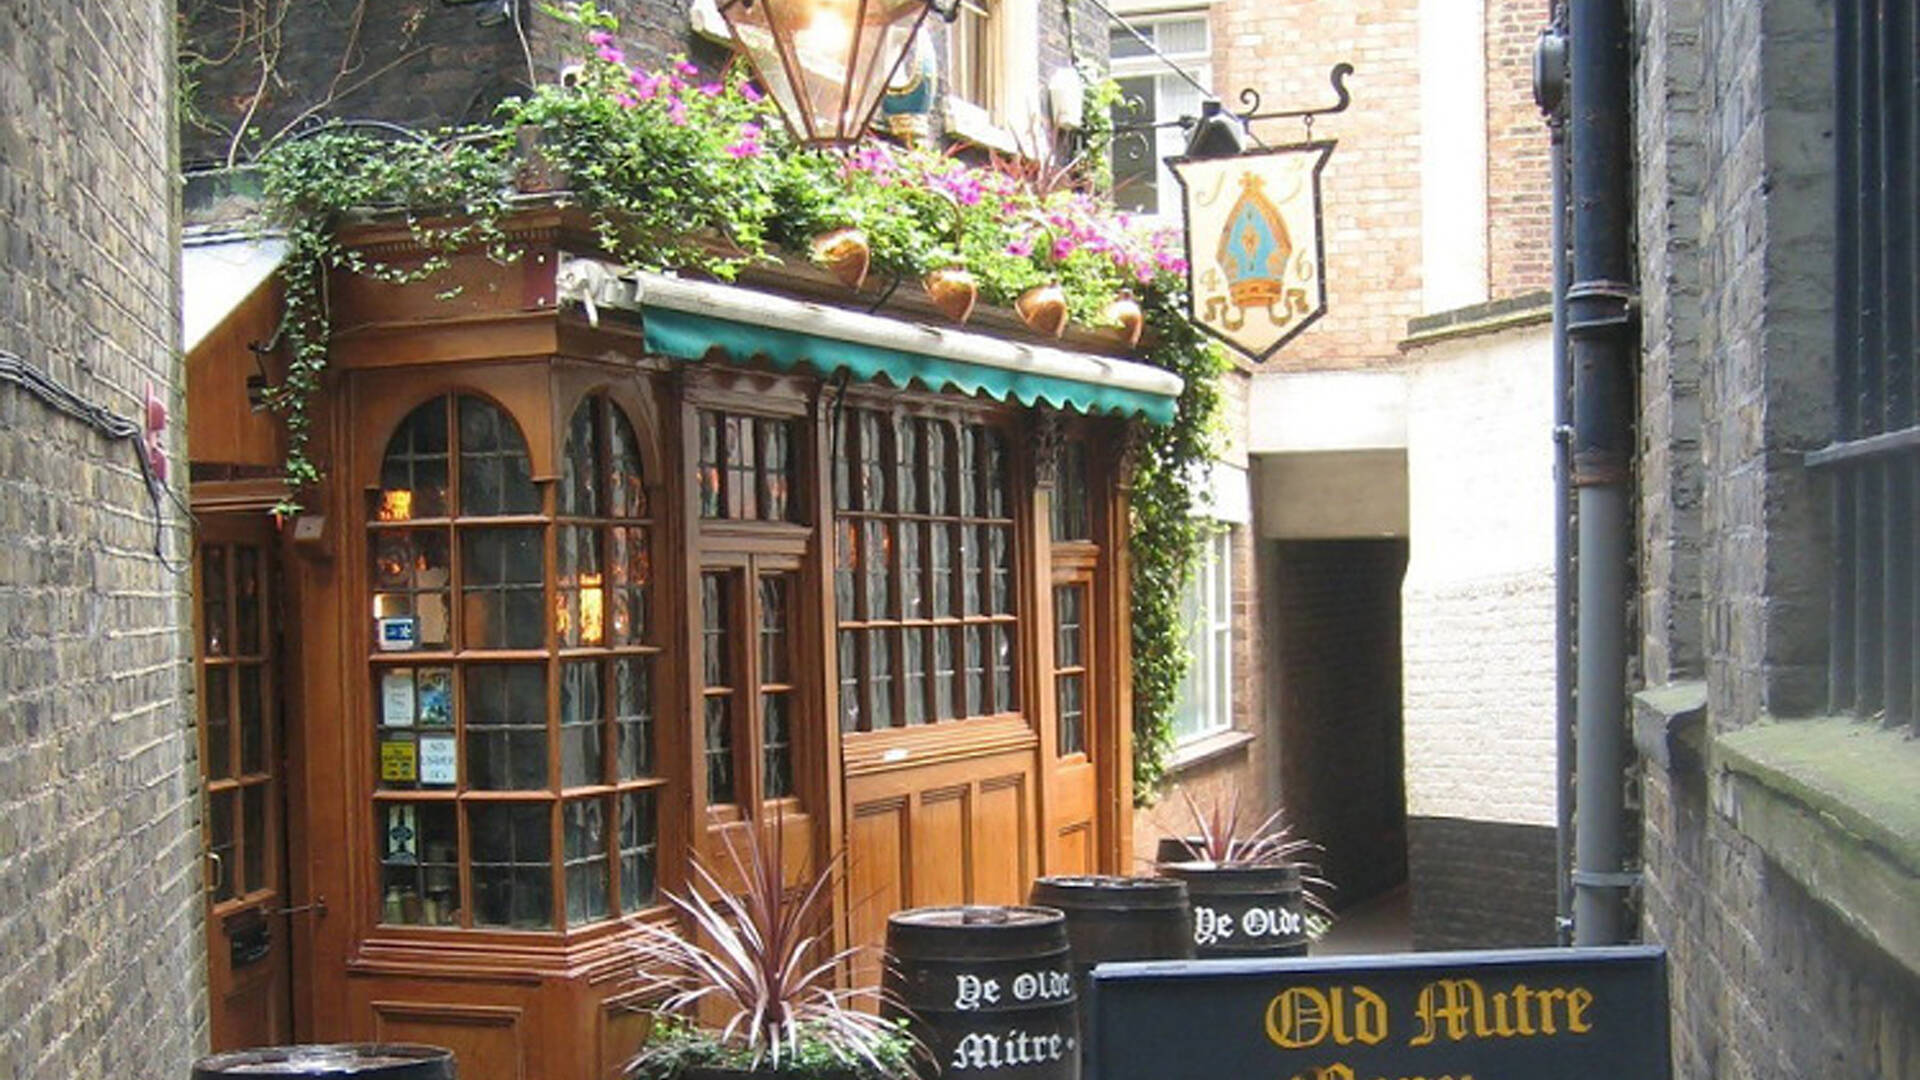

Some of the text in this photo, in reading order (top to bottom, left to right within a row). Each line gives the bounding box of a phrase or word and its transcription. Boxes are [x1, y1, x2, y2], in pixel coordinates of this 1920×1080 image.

[1295, 248, 1314, 282] 6
[1194, 906, 1300, 944] Ye Olde
[954, 970, 1070, 1010] Ye Olde
[1265, 978, 1593, 1048] Old Mitre
